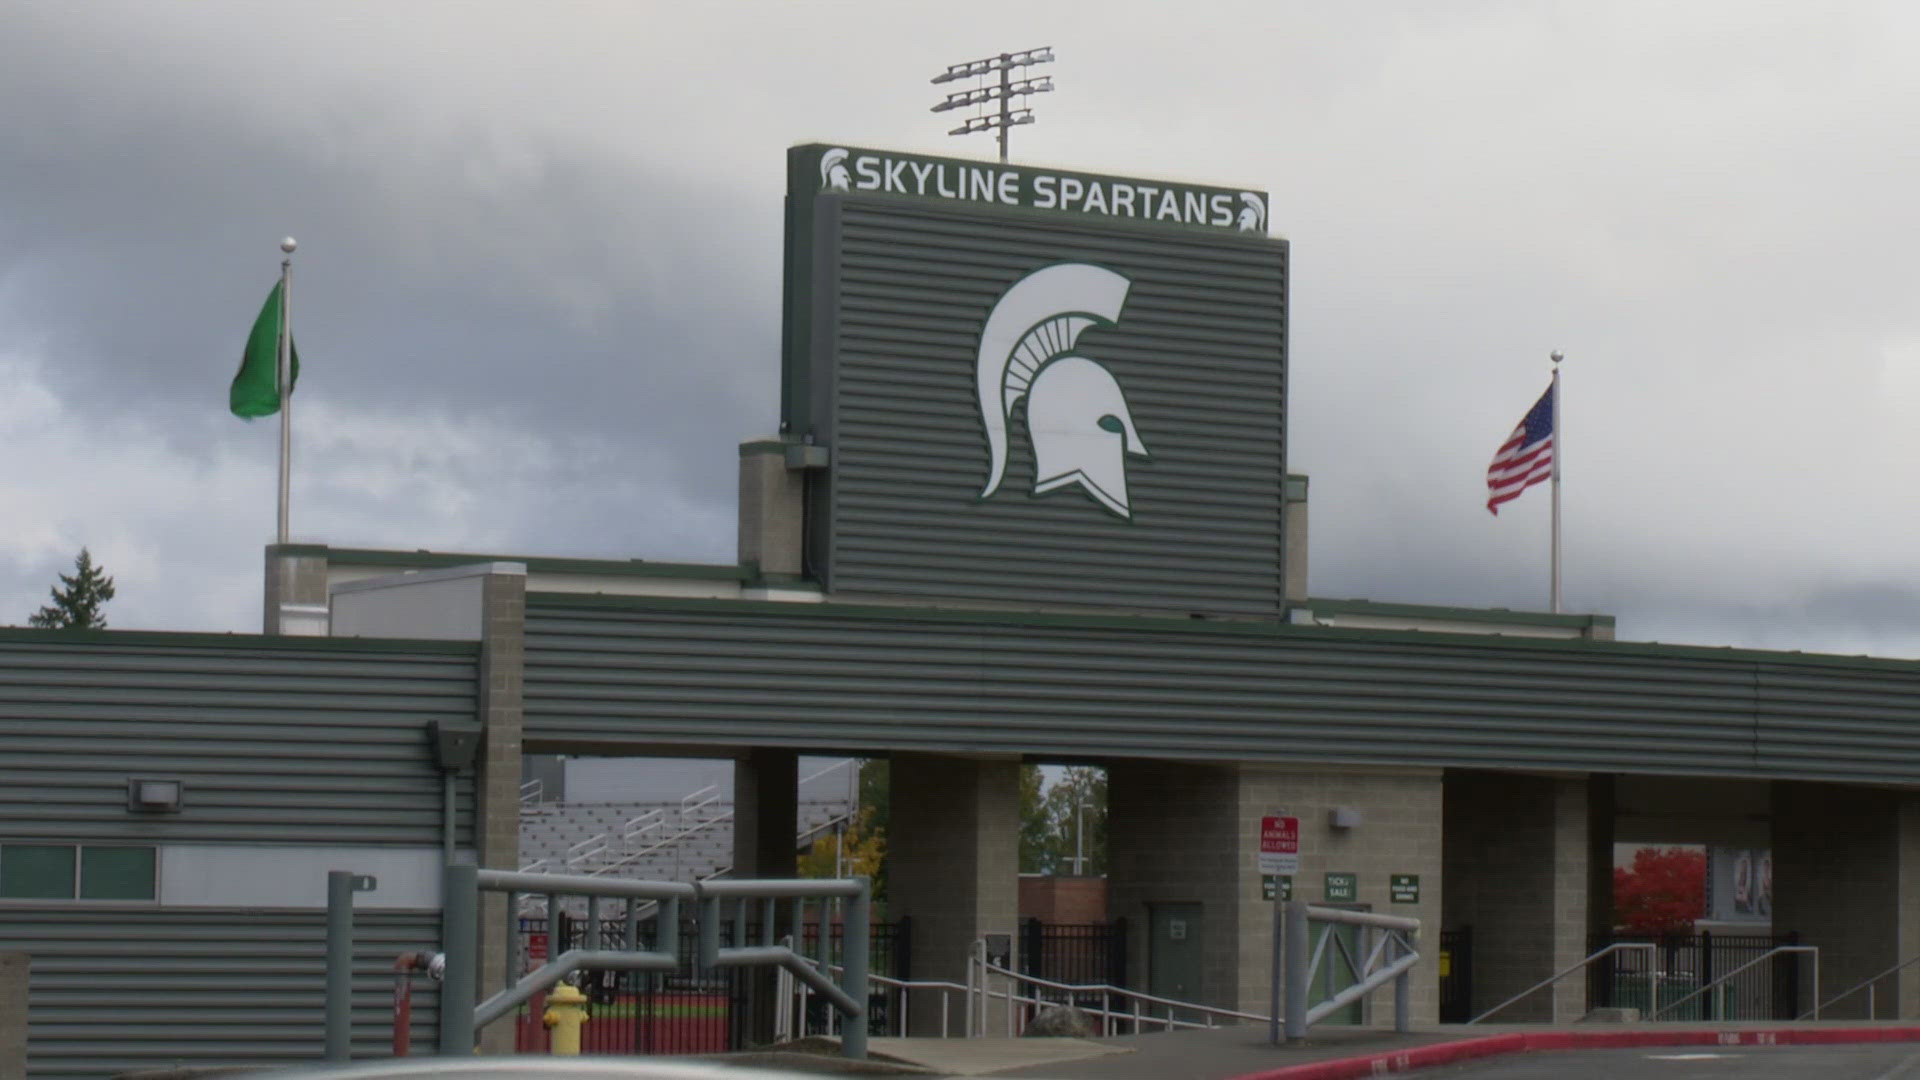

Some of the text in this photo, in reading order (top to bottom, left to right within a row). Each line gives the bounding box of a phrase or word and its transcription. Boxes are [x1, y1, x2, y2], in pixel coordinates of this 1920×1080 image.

[856, 156, 1233, 227] SKYLINE SPARTANS
[1274, 820, 1286, 829] NO
[1263, 830, 1296, 839] ANIMALS
[1263, 841, 1296, 850] ALLOWED
